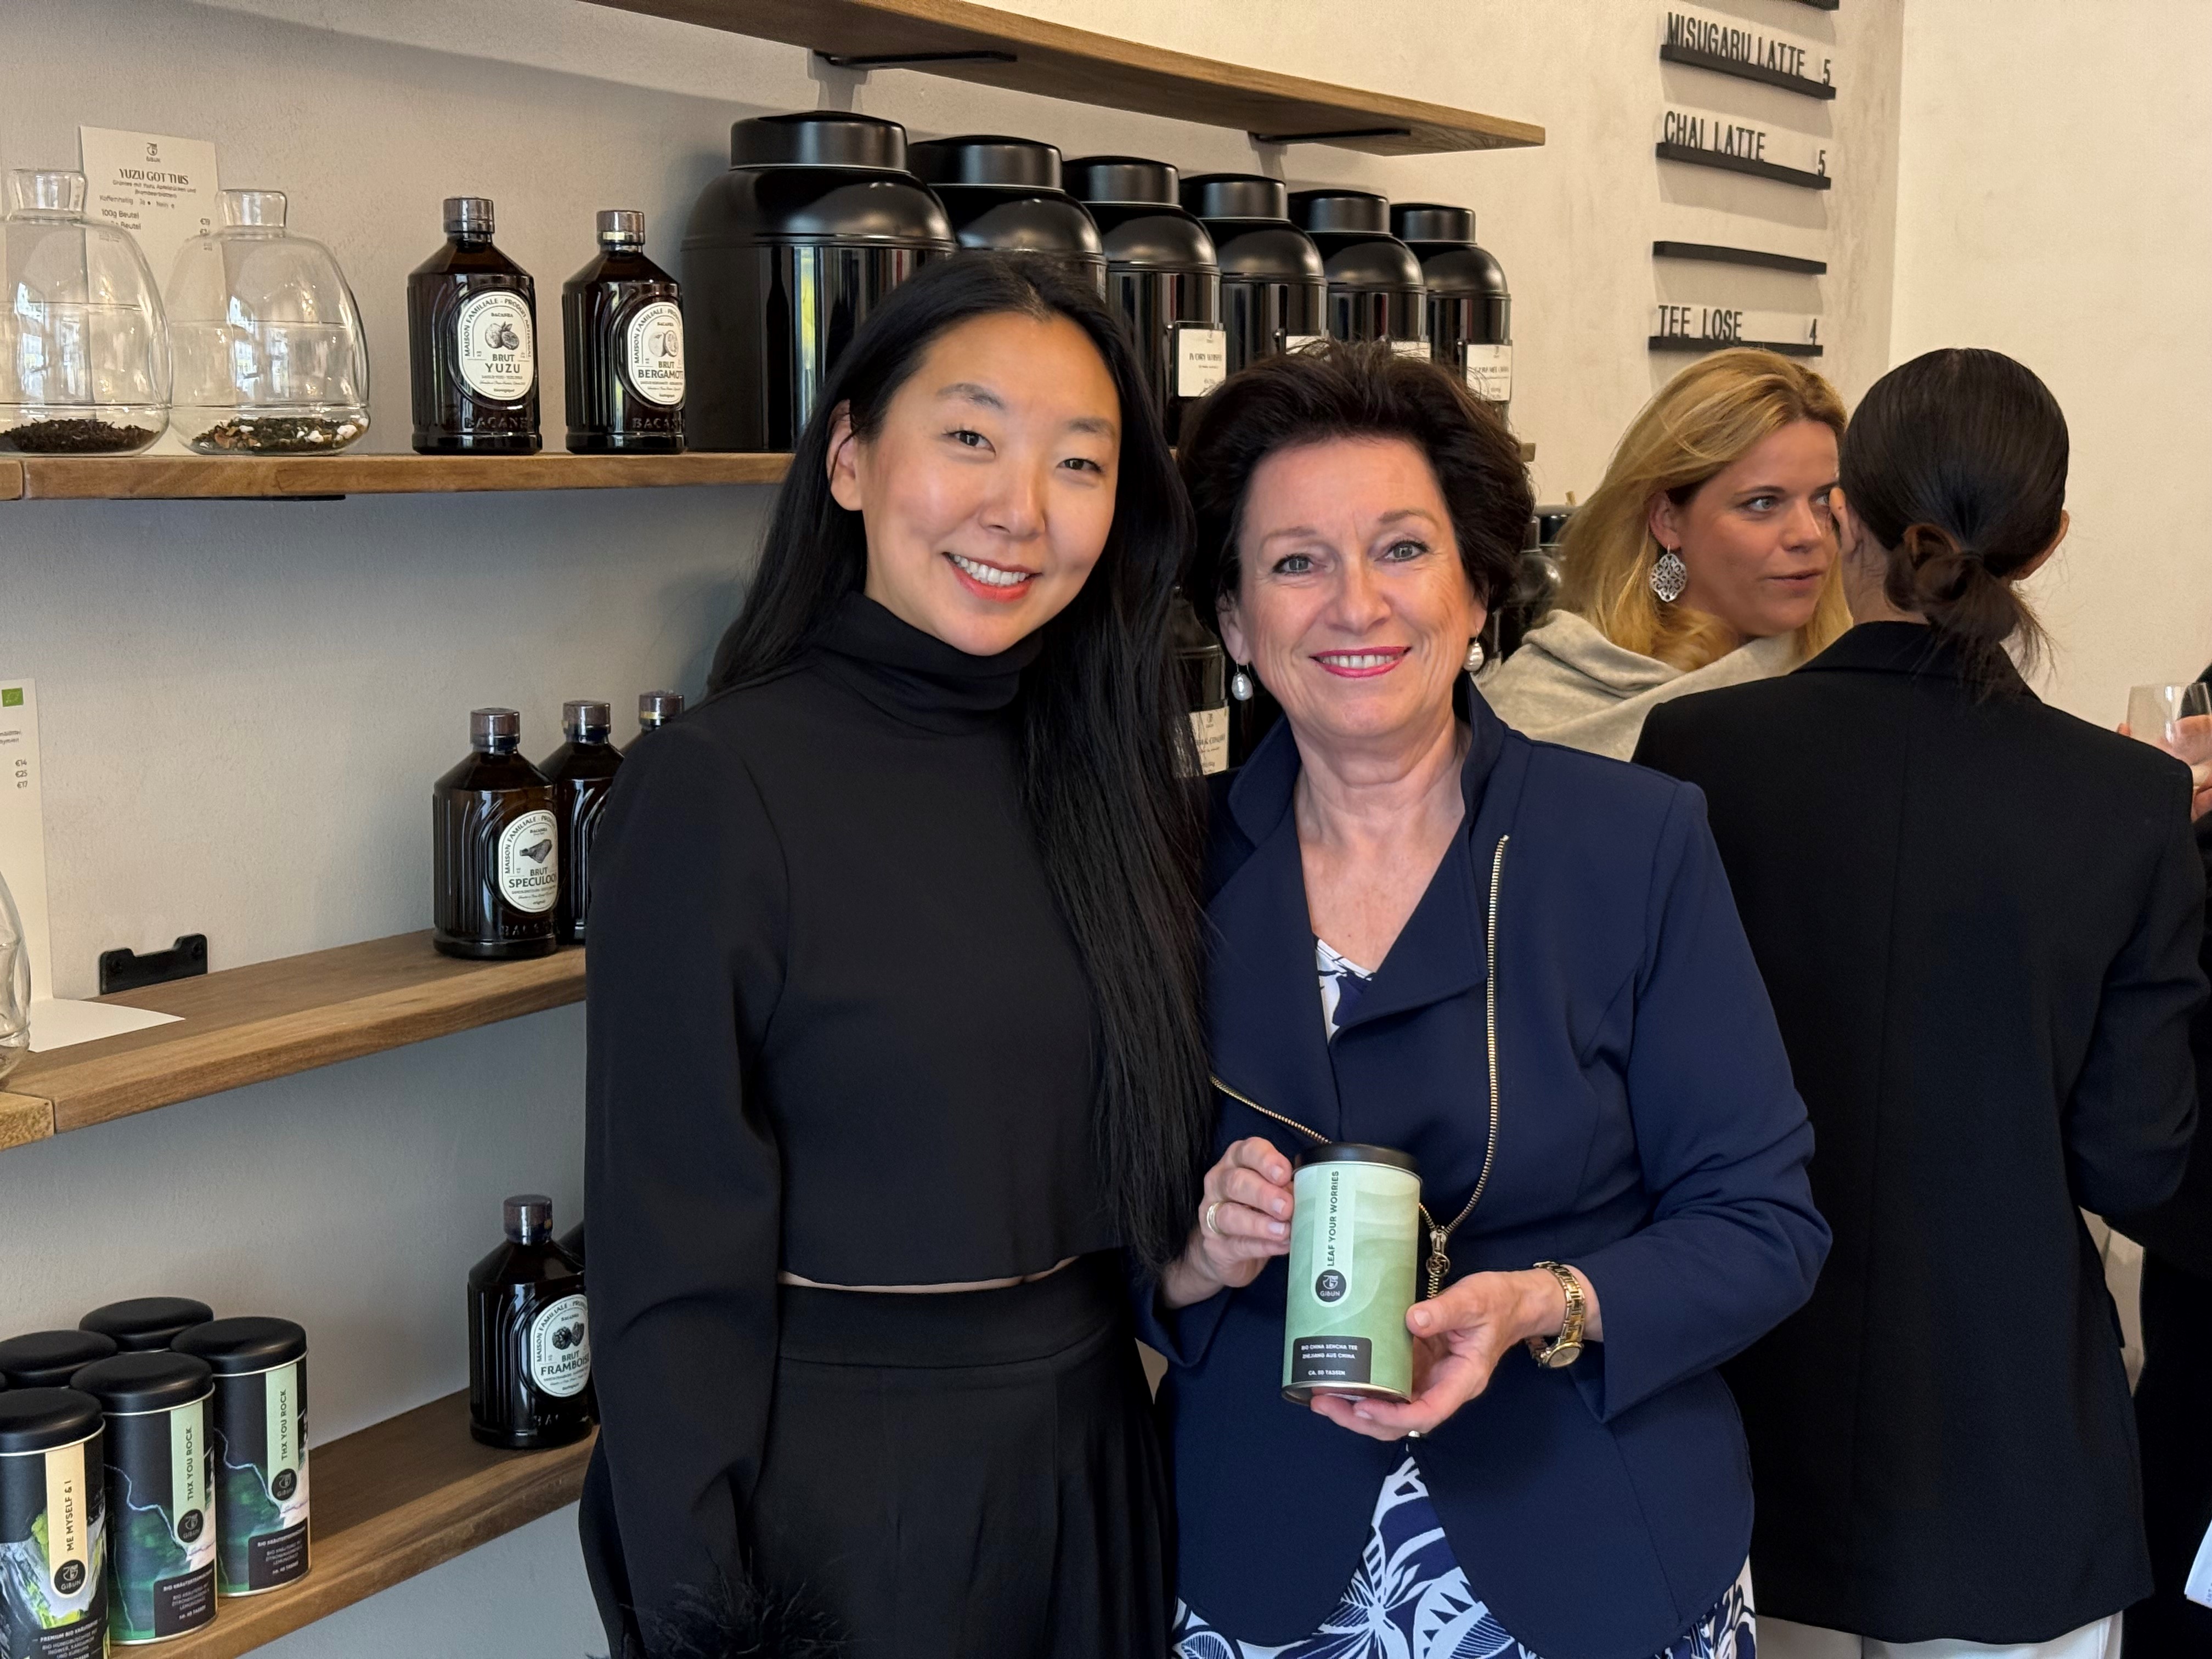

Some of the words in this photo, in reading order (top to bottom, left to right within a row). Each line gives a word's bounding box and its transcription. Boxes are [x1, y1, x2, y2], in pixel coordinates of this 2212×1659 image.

[1667, 12, 1752, 63] MISUGARU
[1757, 36, 1805, 78] LATTE
[1823, 59, 1831, 86] 5
[1664, 111, 1705, 149] CHAI
[1714, 121, 1766, 162] LATTE
[1818, 149, 1826, 177] 5
[119, 168, 144, 180] YUZU
[146, 171, 166, 183] GOT
[101, 208, 117, 219] 100g
[119, 210, 139, 219] Beutel
[466, 298, 500, 324] FAMILIALE
[1658, 305, 1691, 338] TEE
[1702, 308, 1743, 342] LOSE
[1809, 318, 1817, 346] 4
[492, 353, 516, 362] BRUT
[658, 361, 675, 369] BRUT
[485, 363, 521, 374] YUZU
[507, 816, 537, 843] FAMILIALE
[530, 866, 549, 877] BRUT
[508, 873, 557, 888] SPECULOO
[1330, 1170, 1339, 1216] WORRIES
[1328, 1216, 1337, 1243] YOUR
[1327, 1245, 1335, 1267] LEAF
[561, 1350, 580, 1363] BRUT
[64, 1486, 72, 1494] &
[64, 1494, 75, 1535] MYSELF
[66, 1535, 75, 1553] ME
[61, 1578, 82, 1591] GIBUN
[40, 1632, 65, 1643] PREMIUM
